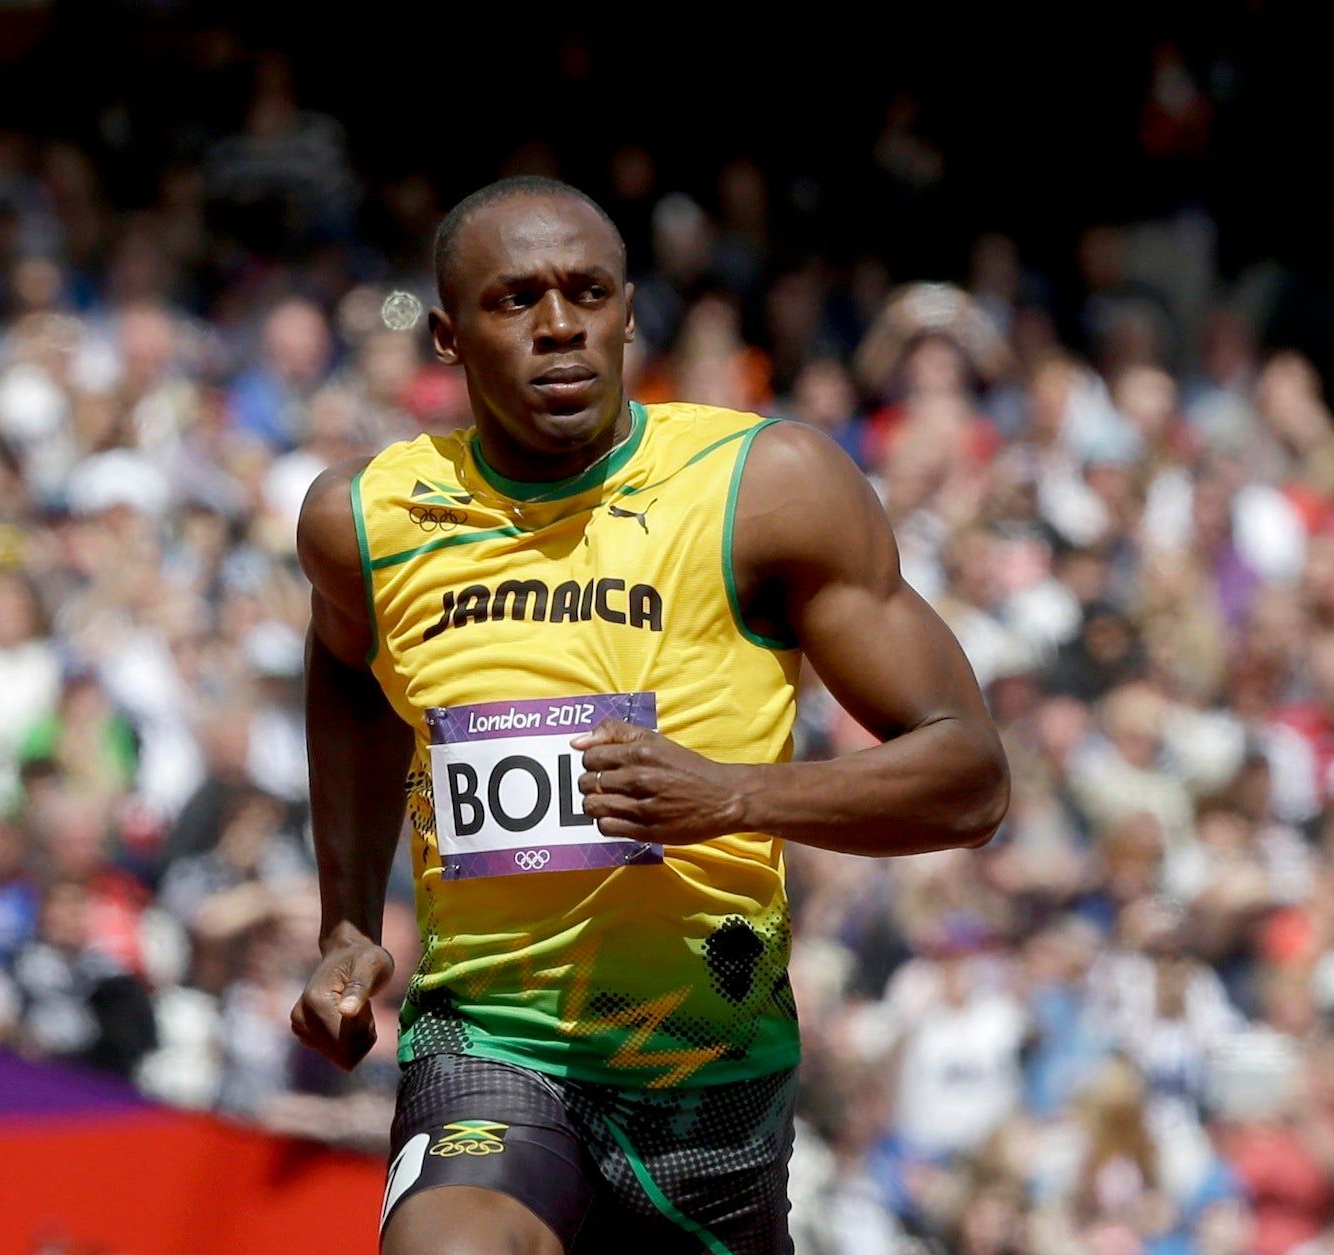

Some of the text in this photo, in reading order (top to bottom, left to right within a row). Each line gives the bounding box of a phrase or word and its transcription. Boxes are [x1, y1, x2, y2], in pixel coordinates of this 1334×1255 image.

[423, 578, 663, 641] JAMAICA
[468, 703, 595, 733] London 2012
[447, 753, 595, 836] BOL
